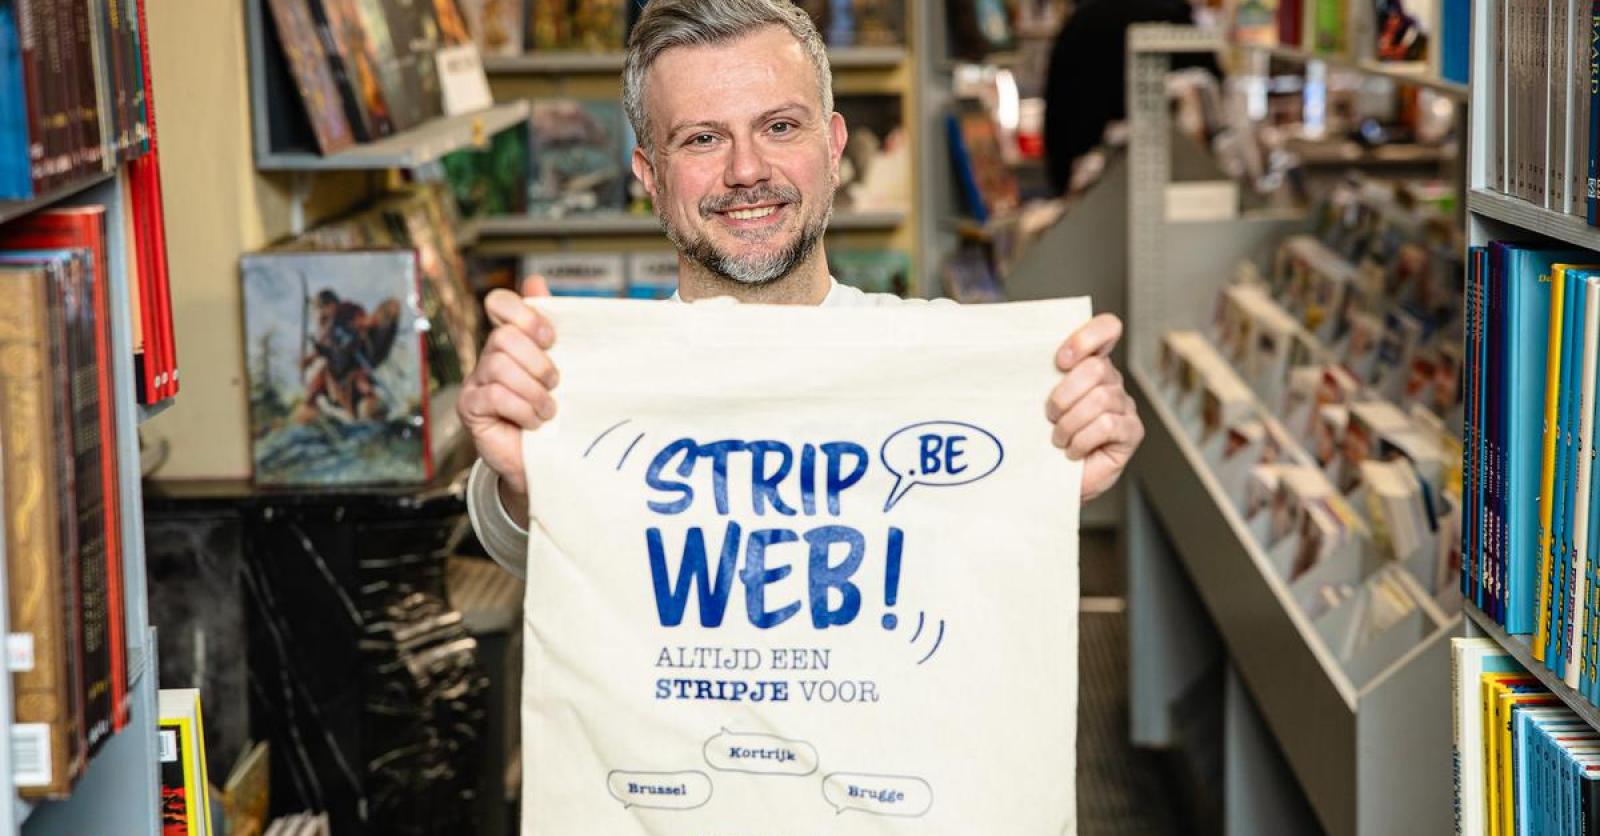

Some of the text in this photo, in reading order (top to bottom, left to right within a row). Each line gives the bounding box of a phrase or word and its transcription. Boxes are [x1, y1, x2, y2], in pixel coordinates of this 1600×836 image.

[908, 434, 968, 475] .BE
[645, 437, 869, 516] STRIP
[645, 521, 905, 631] WEB!
[656, 647, 831, 671] ALTIJD EEN
[656, 678, 880, 703] STRIPJE VOOR
[729, 746, 797, 763] Kortrijk
[627, 783, 687, 798] Brussel
[848, 786, 905, 803] Brugge
